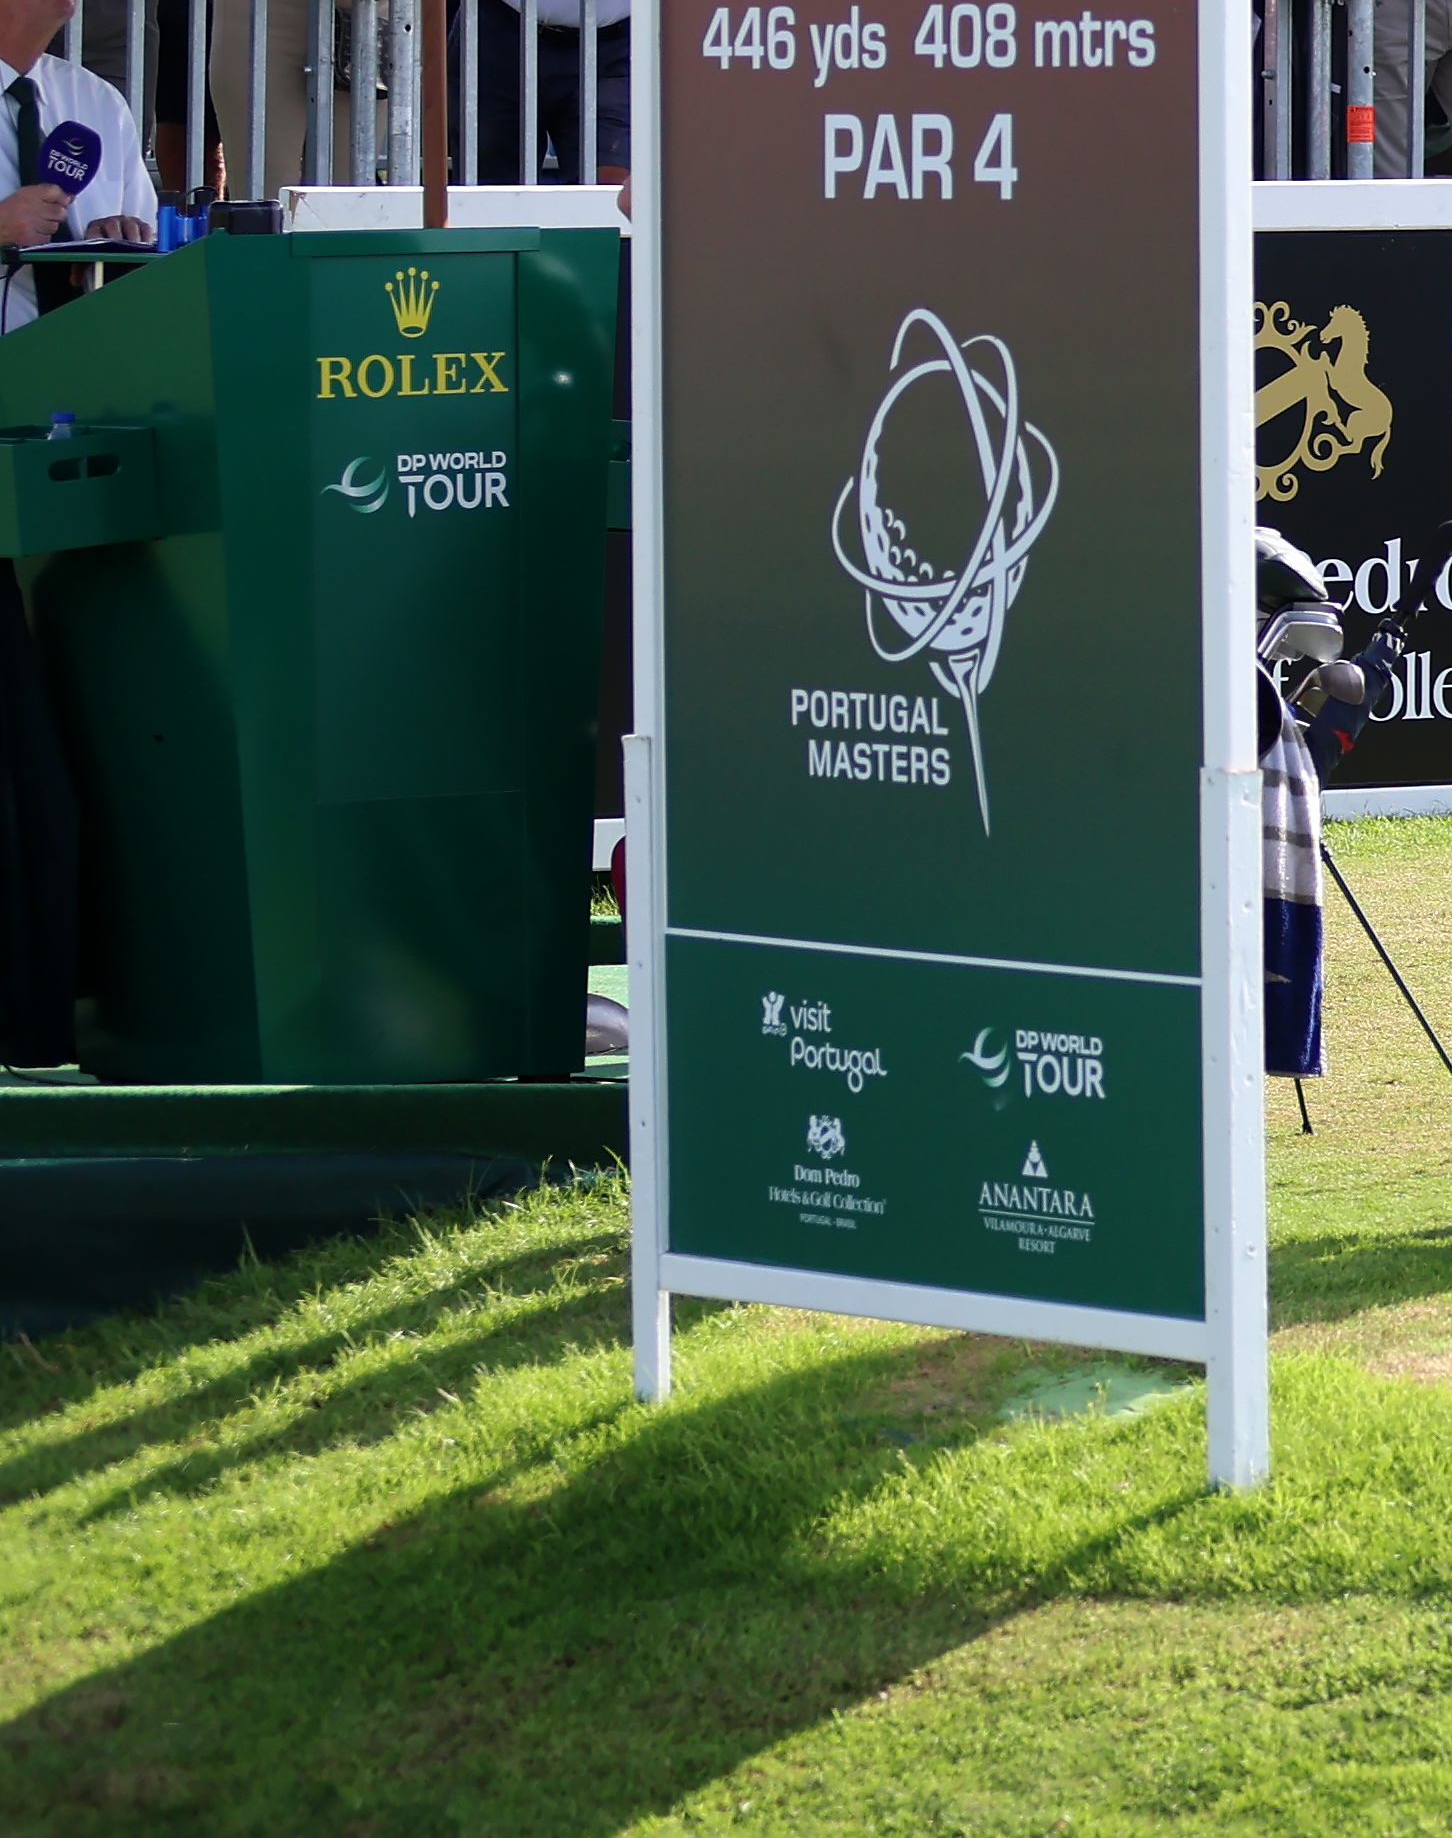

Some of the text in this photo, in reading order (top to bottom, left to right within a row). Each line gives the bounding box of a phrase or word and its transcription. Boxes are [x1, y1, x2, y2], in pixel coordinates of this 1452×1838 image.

[702, 4, 1156, 87] 446 yds 408 mtrs
[48, 155, 85, 181] TOUR
[823, 113, 1018, 200] PAR 4
[317, 351, 509, 399] ROLEX
[397, 450, 507, 472] DP WORLD
[398, 471, 509, 518] TOUR
[790, 689, 950, 737] PORTUGAL
[808, 739, 951, 786] MASTERS
[790, 999, 832, 1033] visit
[1015, 1029, 1103, 1056] DP WORLD
[790, 1036, 888, 1094] Portugal
[1016, 1051, 1106, 1099] TOUR
[768, 1185, 801, 1204] Hotels
[809, 1190, 832, 1208] Golf
[794, 1164, 860, 1188] Dom Pedro
[979, 1181, 1095, 1218] ANANTARA
[1018, 1236, 1056, 1254] RESORT
